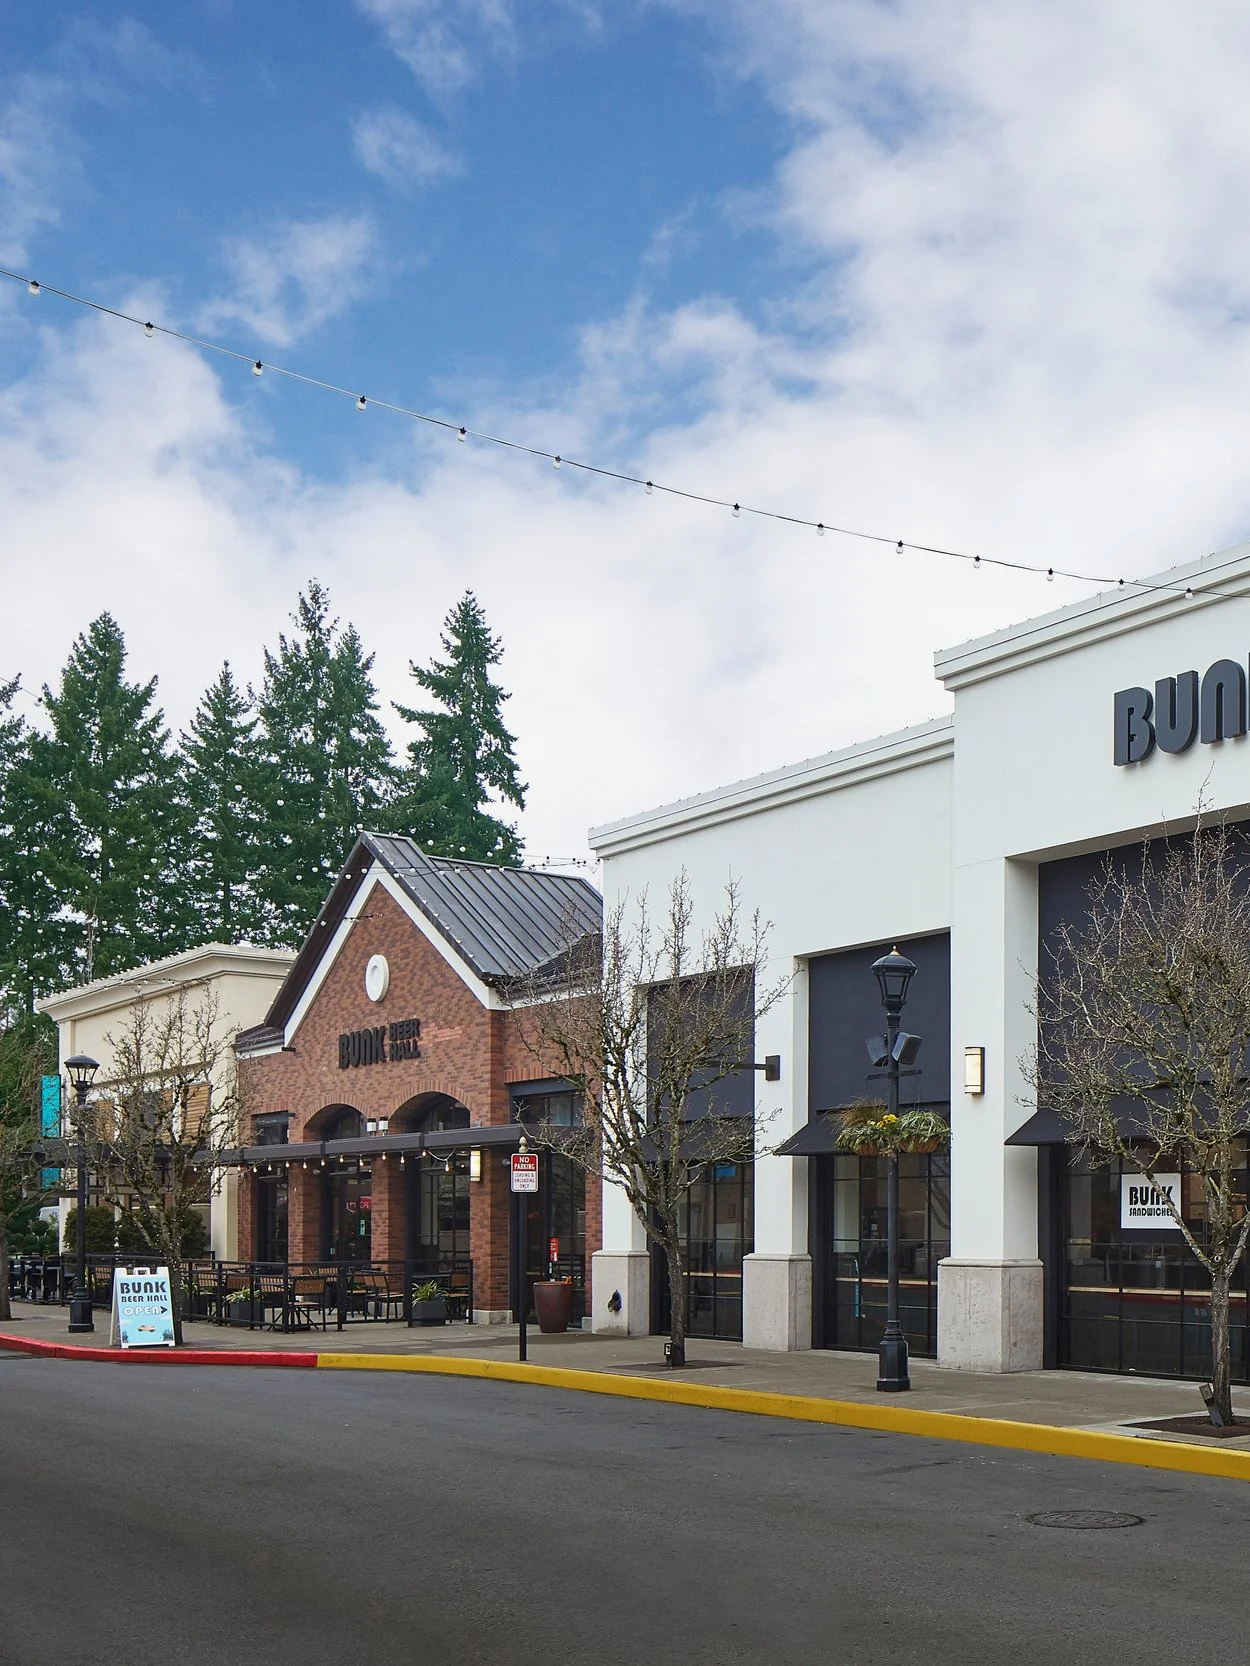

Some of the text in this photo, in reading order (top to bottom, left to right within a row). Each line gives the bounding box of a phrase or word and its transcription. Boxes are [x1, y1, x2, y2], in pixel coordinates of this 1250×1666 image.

[389, 1018, 421, 1041] BEER
[339, 1025, 387, 1069] BUNK
[389, 1039, 421, 1062] HALL
[1129, 1186, 1176, 1206] BUNK
[120, 1281, 167, 1294] BUNK
[121, 1294, 168, 1303] BEER HALL
[123, 1305, 160, 1316] OPEN
